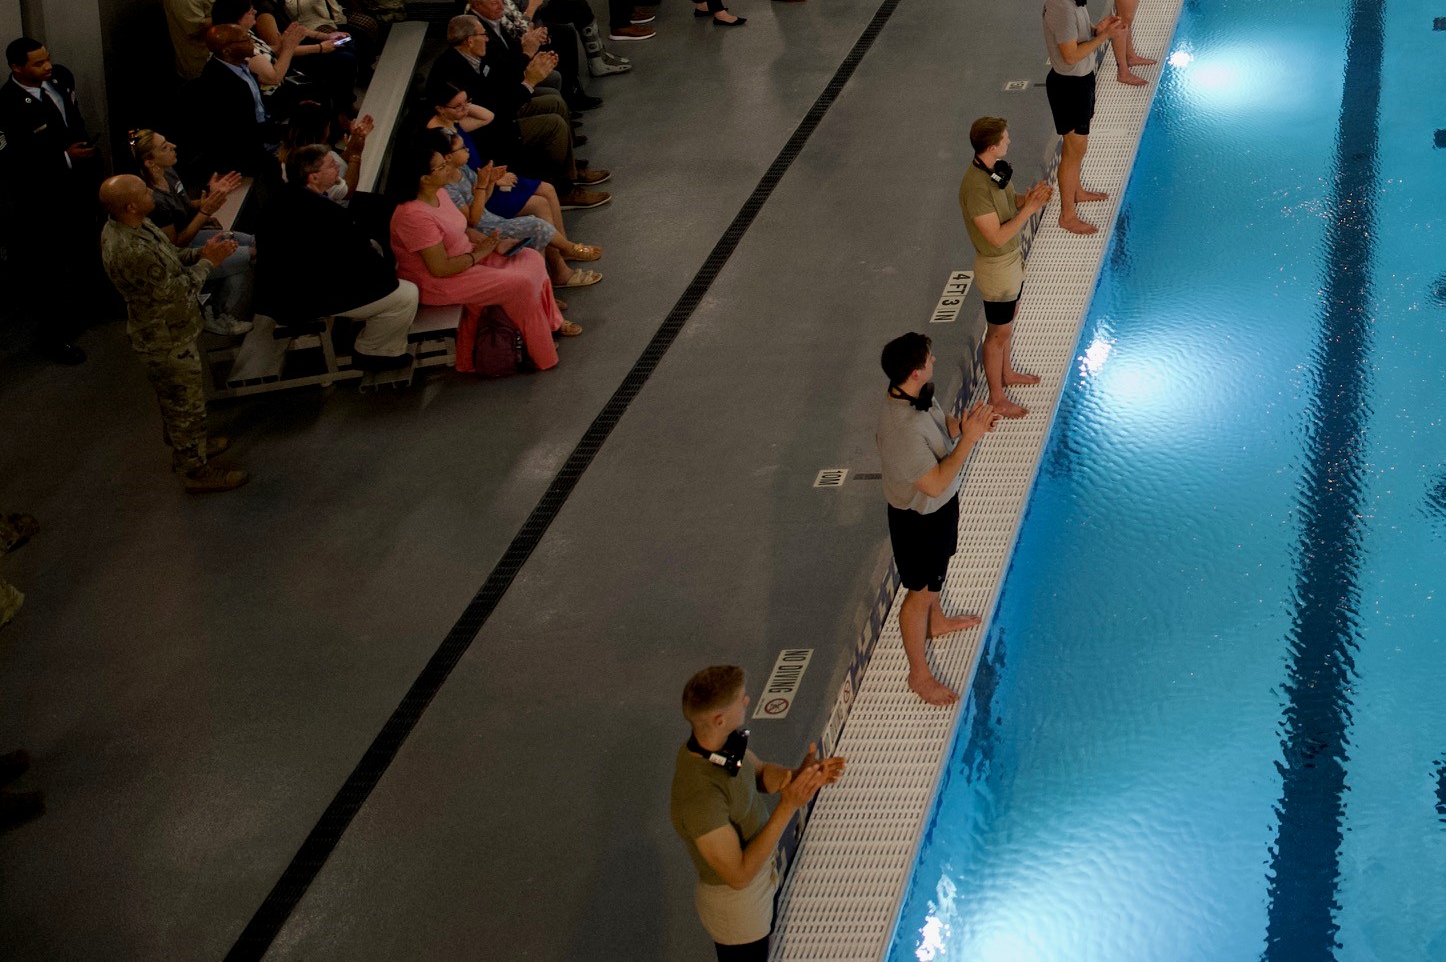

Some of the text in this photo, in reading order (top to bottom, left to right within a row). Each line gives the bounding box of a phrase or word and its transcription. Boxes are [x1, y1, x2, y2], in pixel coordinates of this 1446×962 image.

[947, 283, 967, 295] FT
[934, 310, 956, 321] IN
[818, 470, 843, 486] 10M
[768, 650, 809, 694] NO DIVING
